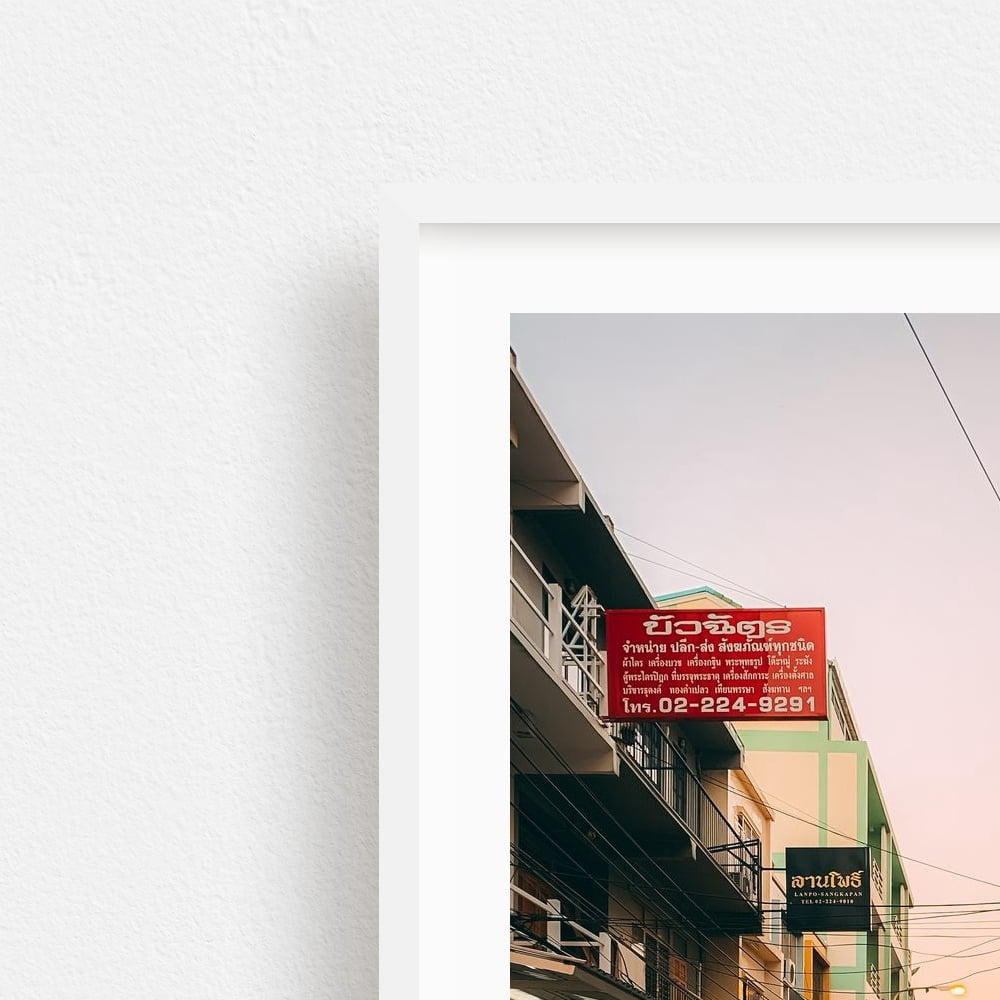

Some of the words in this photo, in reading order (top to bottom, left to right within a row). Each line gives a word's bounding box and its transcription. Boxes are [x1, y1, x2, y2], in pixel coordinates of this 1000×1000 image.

[642, 613, 792, 639] บัวฉัตร
[622, 640, 667, 653] จำหน่าย
[670, 638, 714, 653] ปลีก-ส่ง
[717, 637, 815, 655] สังฆภัณฑ์ทุกชนิด
[622, 656, 644, 667] ผ้าไตร
[648, 654, 682, 667] เครื่องบวช
[725, 656, 763, 669] พระพุทธรูป
